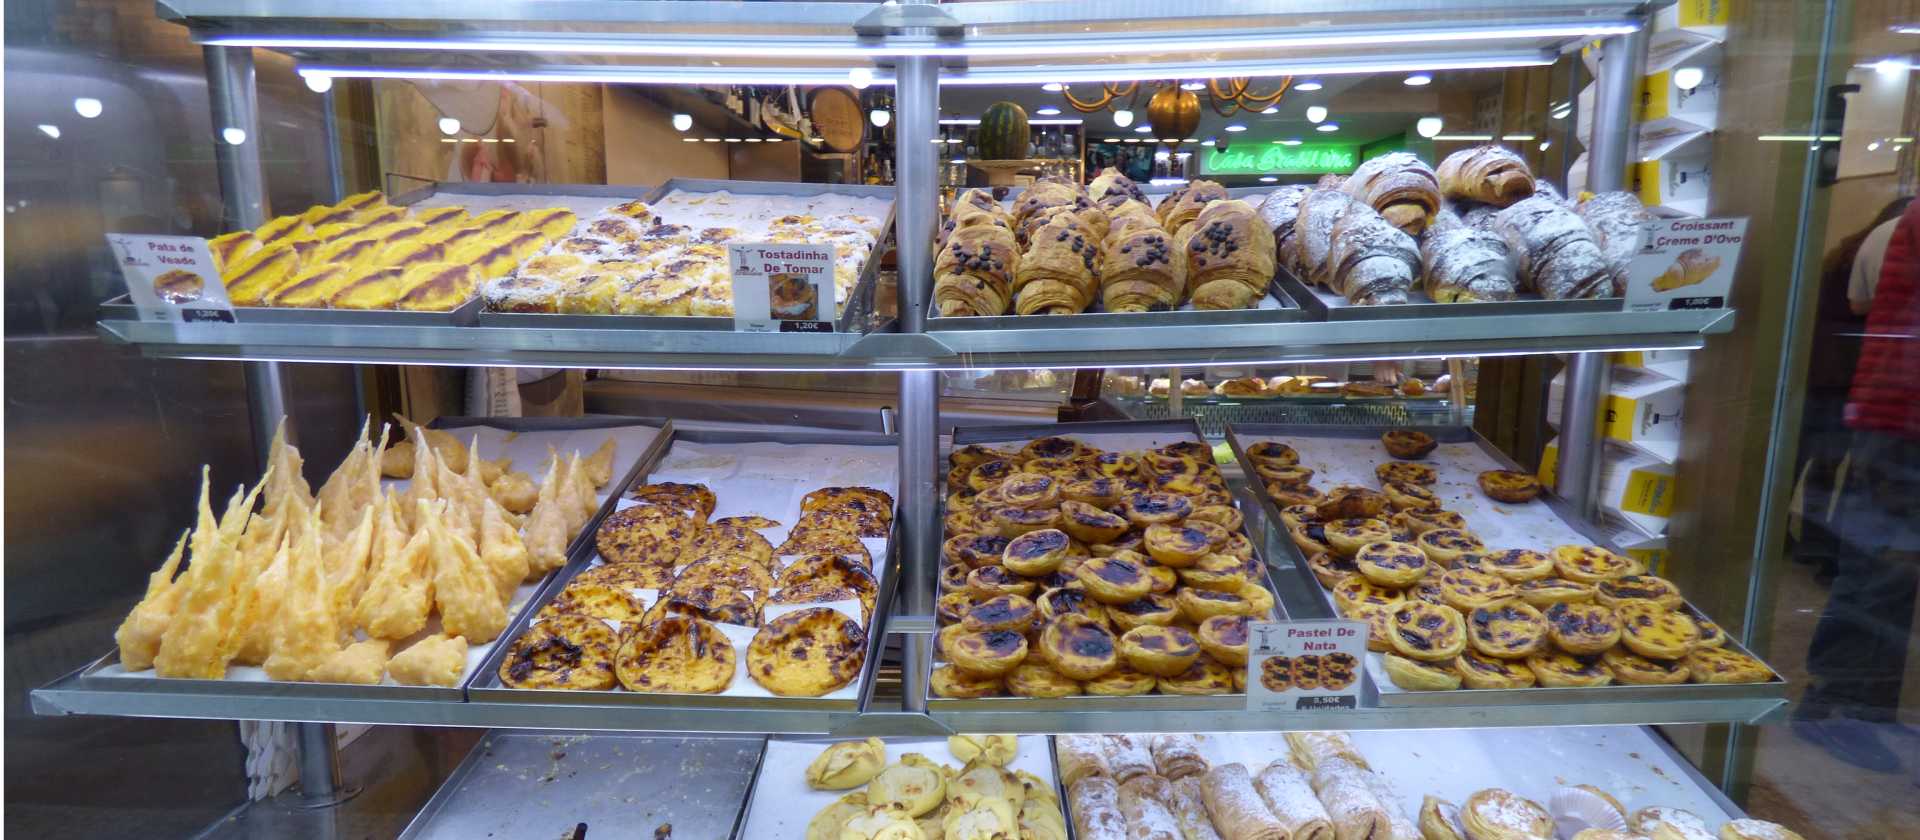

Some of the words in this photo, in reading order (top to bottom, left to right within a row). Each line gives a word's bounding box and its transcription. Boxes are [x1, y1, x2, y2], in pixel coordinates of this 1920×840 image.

[1670, 221, 1735, 232] Croissant
[1656, 236, 1699, 247] Creme
[1703, 234, 1741, 245] D'Ovo
[147, 241, 177, 252] Pata
[180, 242, 195, 253] de
[157, 255, 197, 266] Veado
[757, 249, 829, 261] Tostadinha
[763, 263, 781, 273] De
[783, 263, 825, 274] Tomar
[1287, 628, 1332, 638] Pastel
[1336, 627, 1356, 637] De
[1303, 641, 1337, 651] Nata
